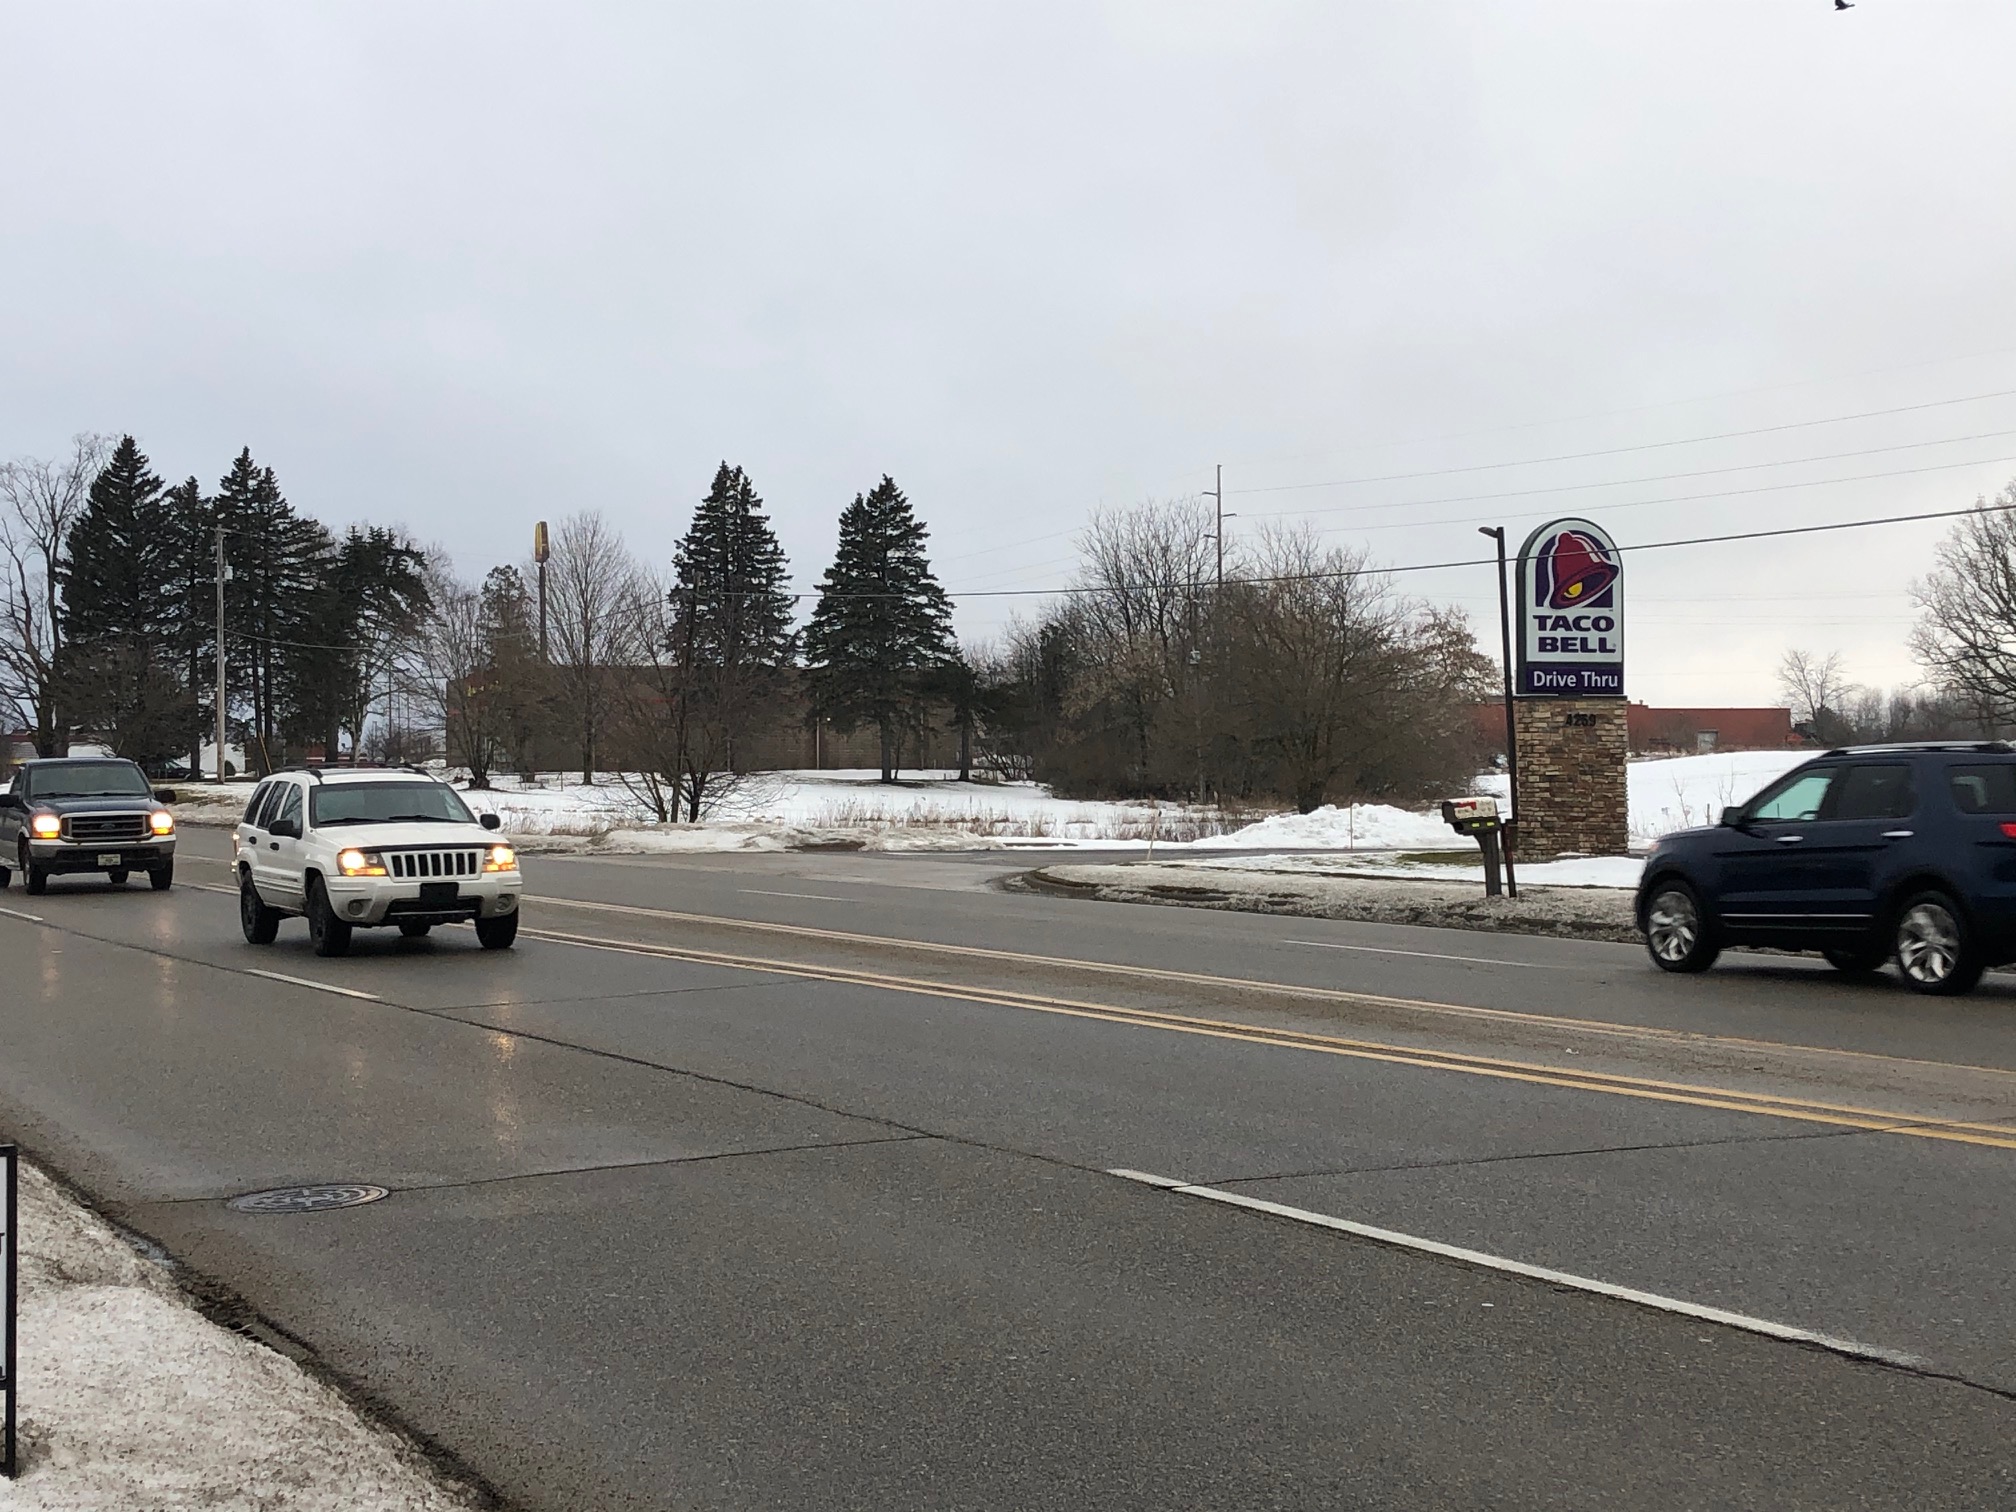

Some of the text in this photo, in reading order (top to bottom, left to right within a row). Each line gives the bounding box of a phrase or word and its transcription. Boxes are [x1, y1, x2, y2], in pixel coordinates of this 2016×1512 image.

[1532, 614, 1615, 632] TACO
[1538, 636, 1616, 653] BELL
[1532, 670, 1618, 687] Drive Thru
